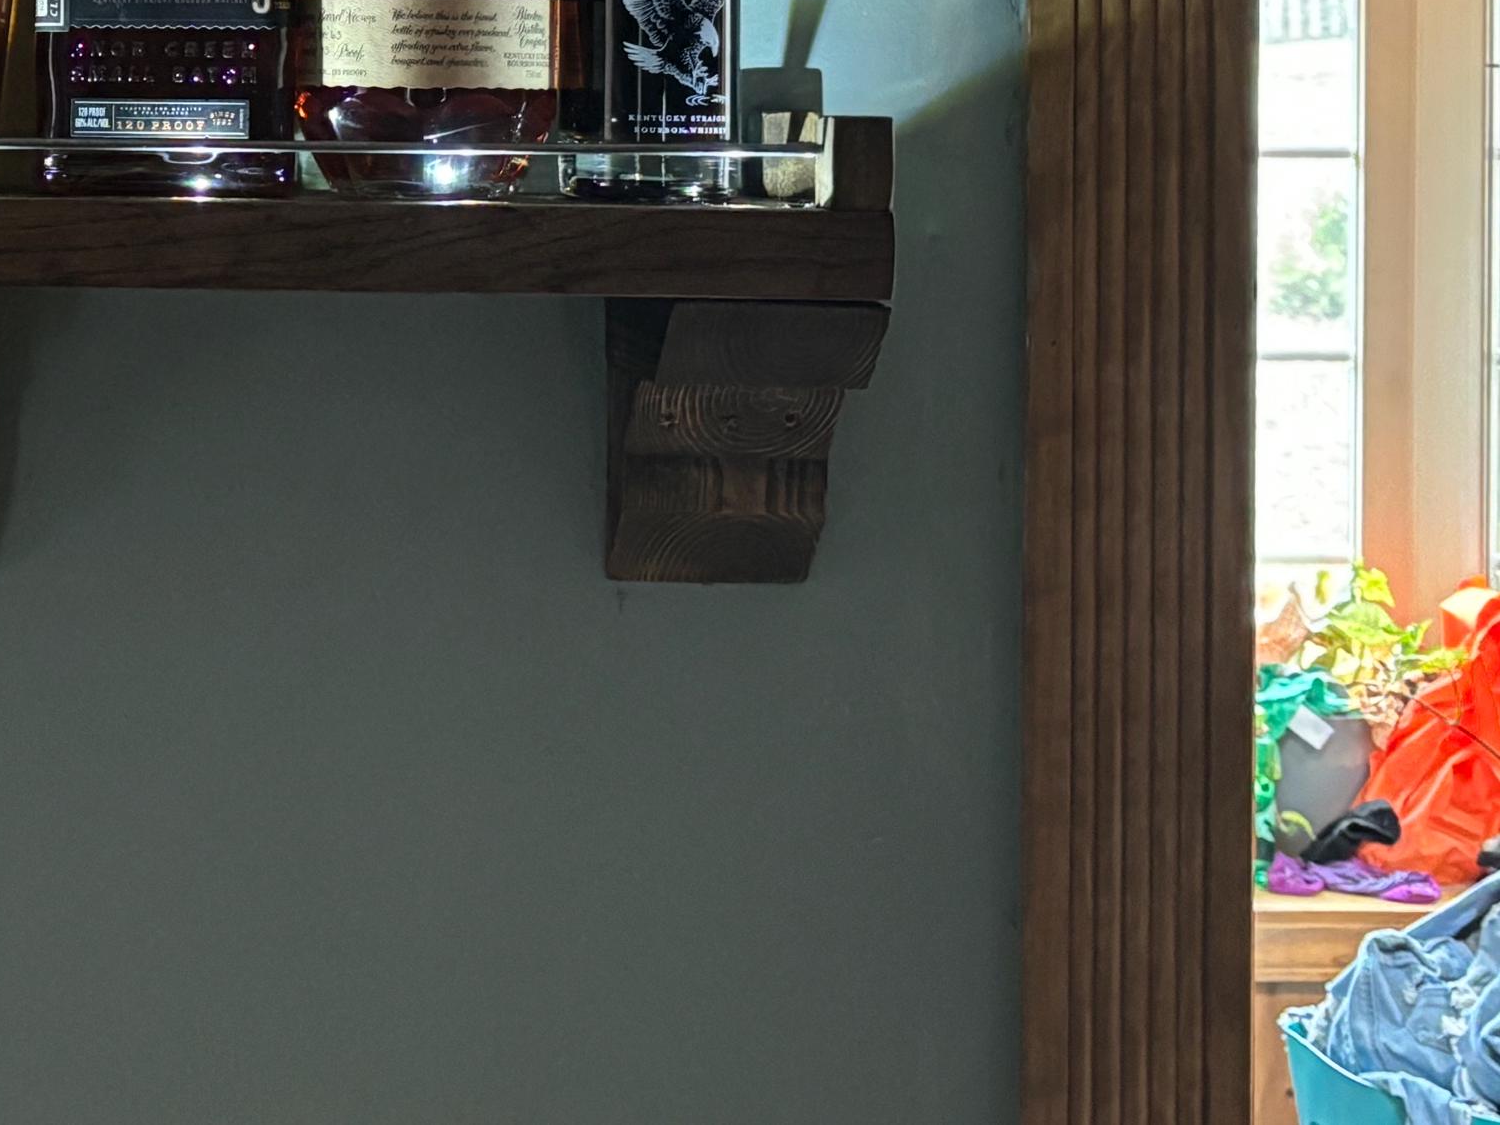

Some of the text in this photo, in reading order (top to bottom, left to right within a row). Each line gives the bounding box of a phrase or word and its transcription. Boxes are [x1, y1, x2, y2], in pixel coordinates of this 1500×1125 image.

[628, 115, 687, 123] KENTUCKY
[116, 120, 205, 131] 120 PROOF
